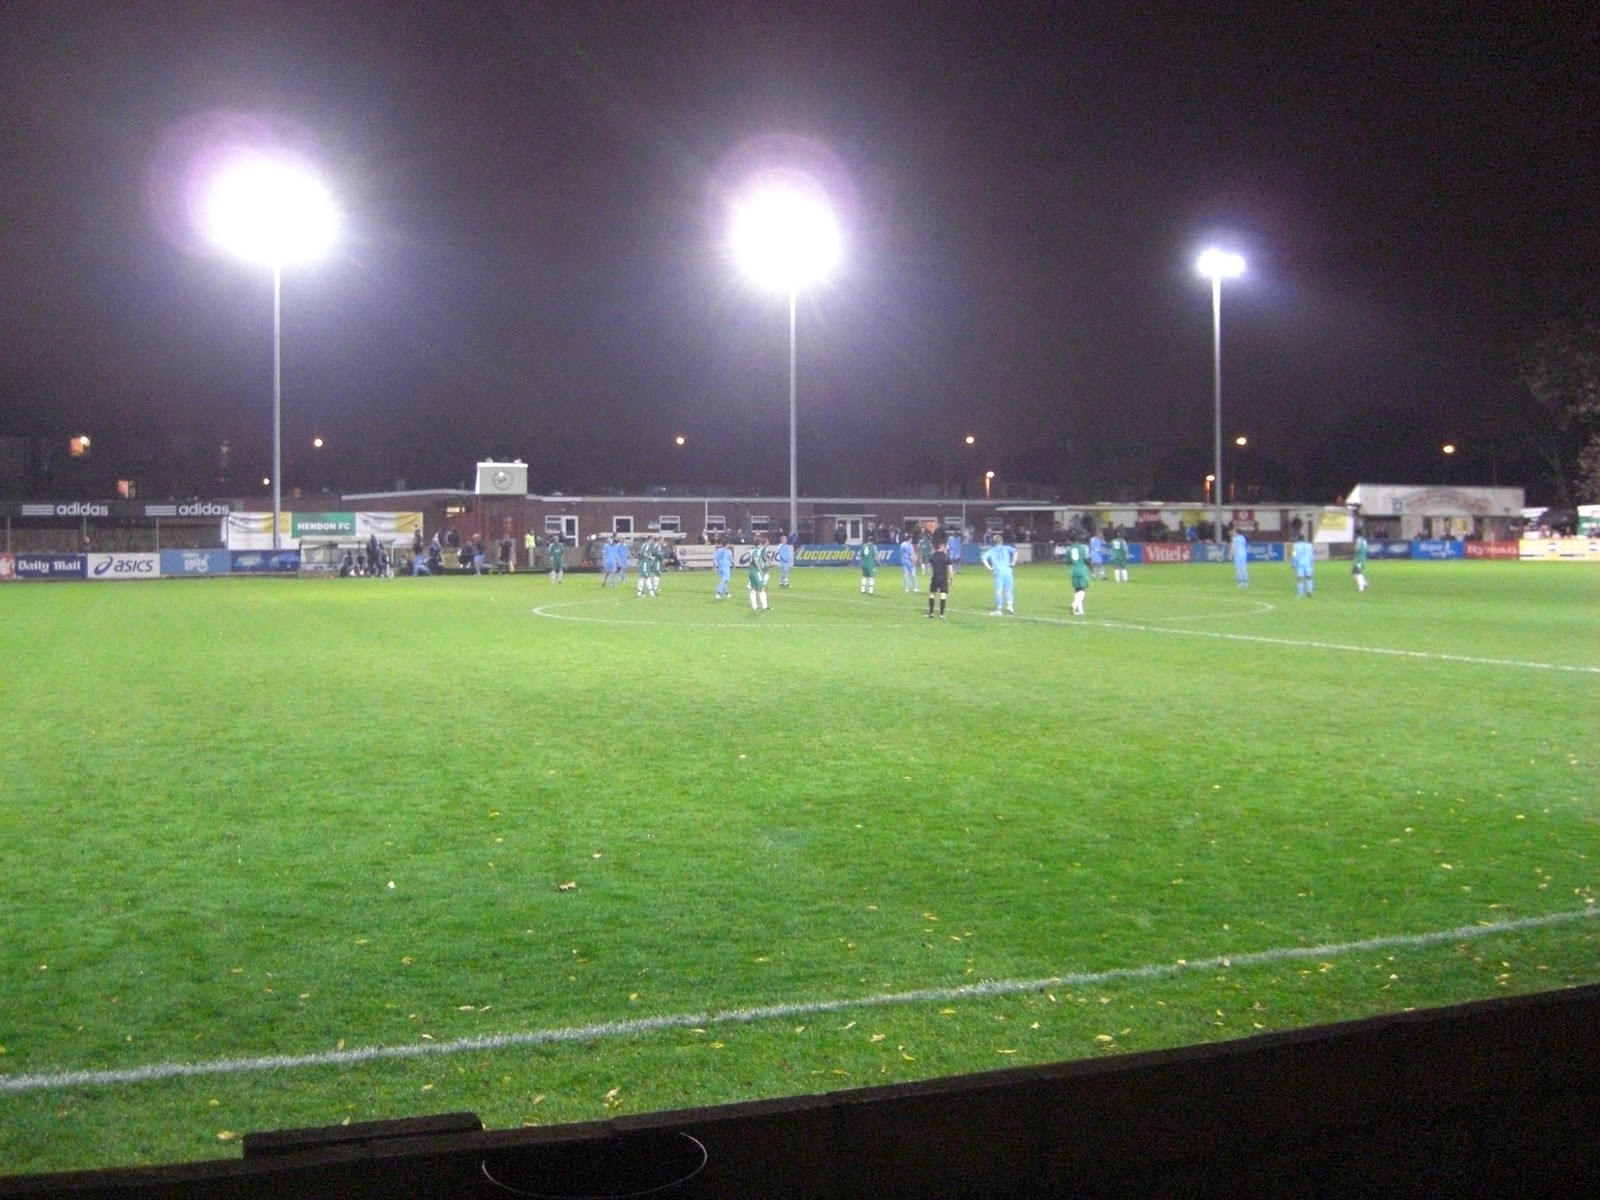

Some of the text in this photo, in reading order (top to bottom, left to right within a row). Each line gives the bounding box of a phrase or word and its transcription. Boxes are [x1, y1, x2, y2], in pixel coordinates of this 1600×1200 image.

[56, 503, 108, 516] adidas
[178, 503, 230, 516] adidas
[298, 522, 351, 531] HENDON FC
[796, 545, 854, 560] Lucozade
[18, 560, 81, 573] Daily Mail
